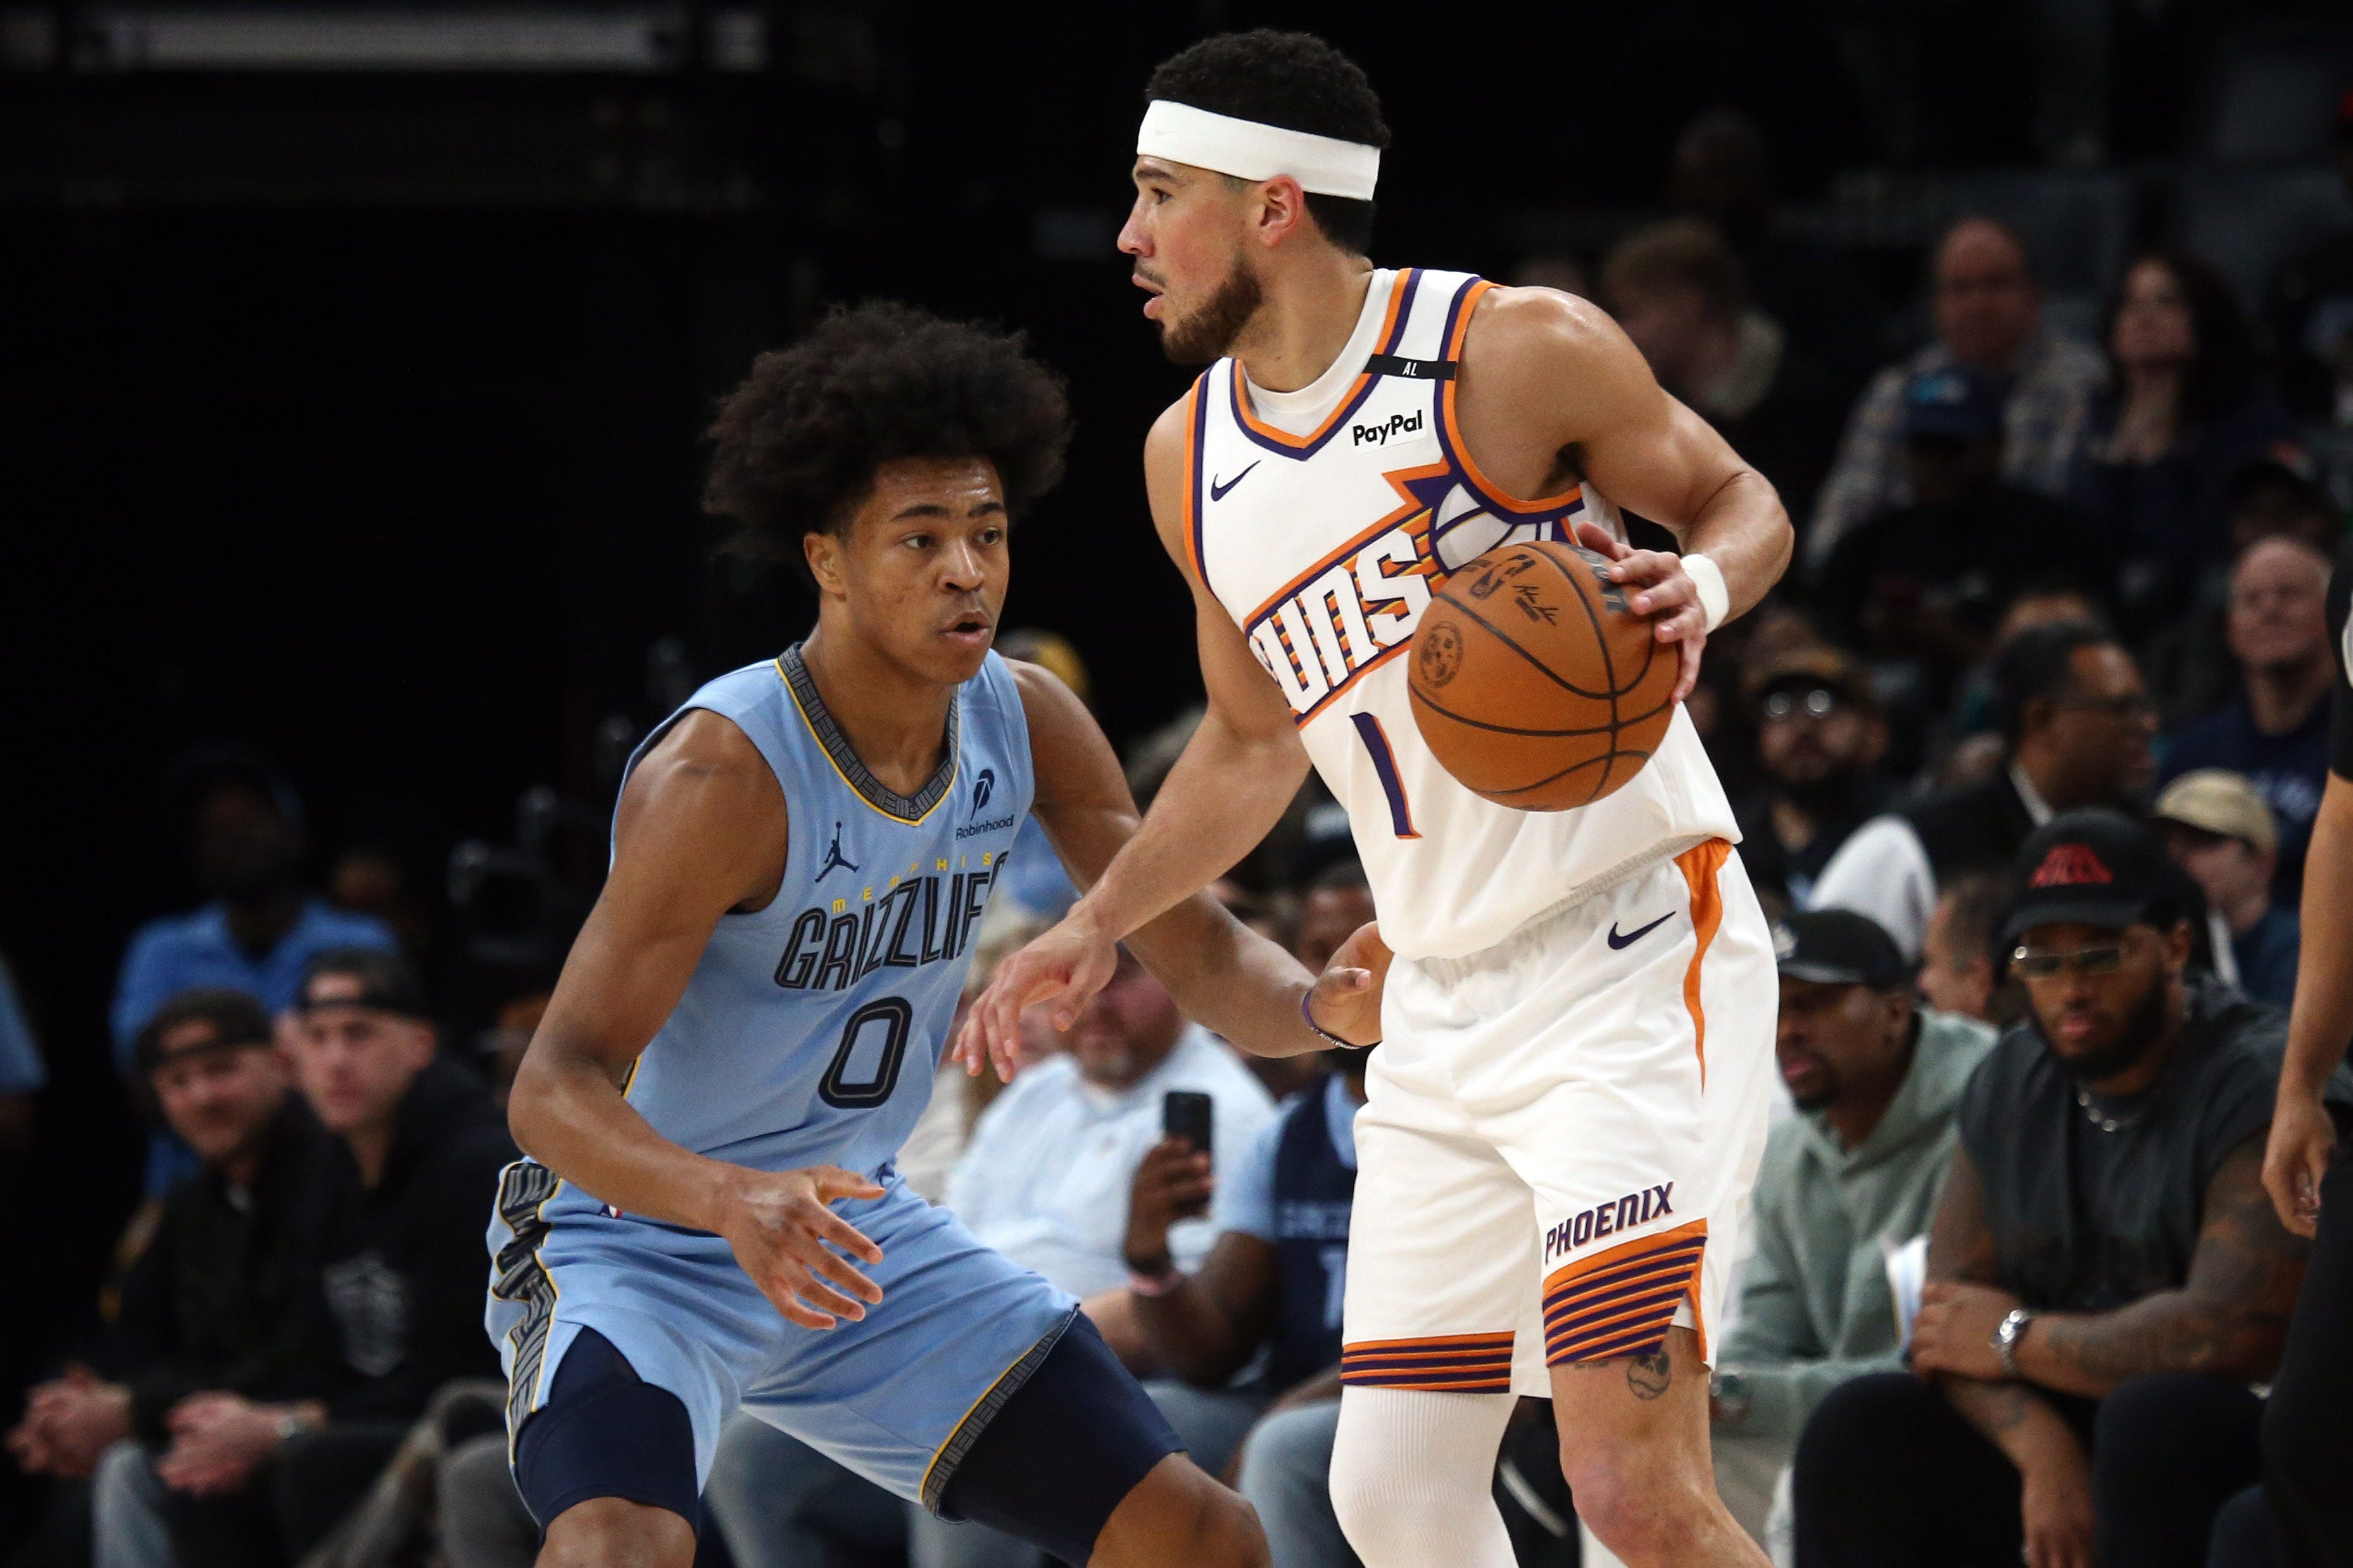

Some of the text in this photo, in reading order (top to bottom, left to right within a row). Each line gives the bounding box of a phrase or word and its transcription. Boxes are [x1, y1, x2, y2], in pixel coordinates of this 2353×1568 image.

[1403, 361, 1417, 376] AL
[1353, 410, 1422, 446] PayPal
[1349, 712, 1422, 839] 1
[956, 816, 1014, 840] Robinhood
[833, 852, 992, 913] MEMPHIS
[818, 996, 912, 1109] 0
[1545, 1181, 1674, 1264] PHOENIX
